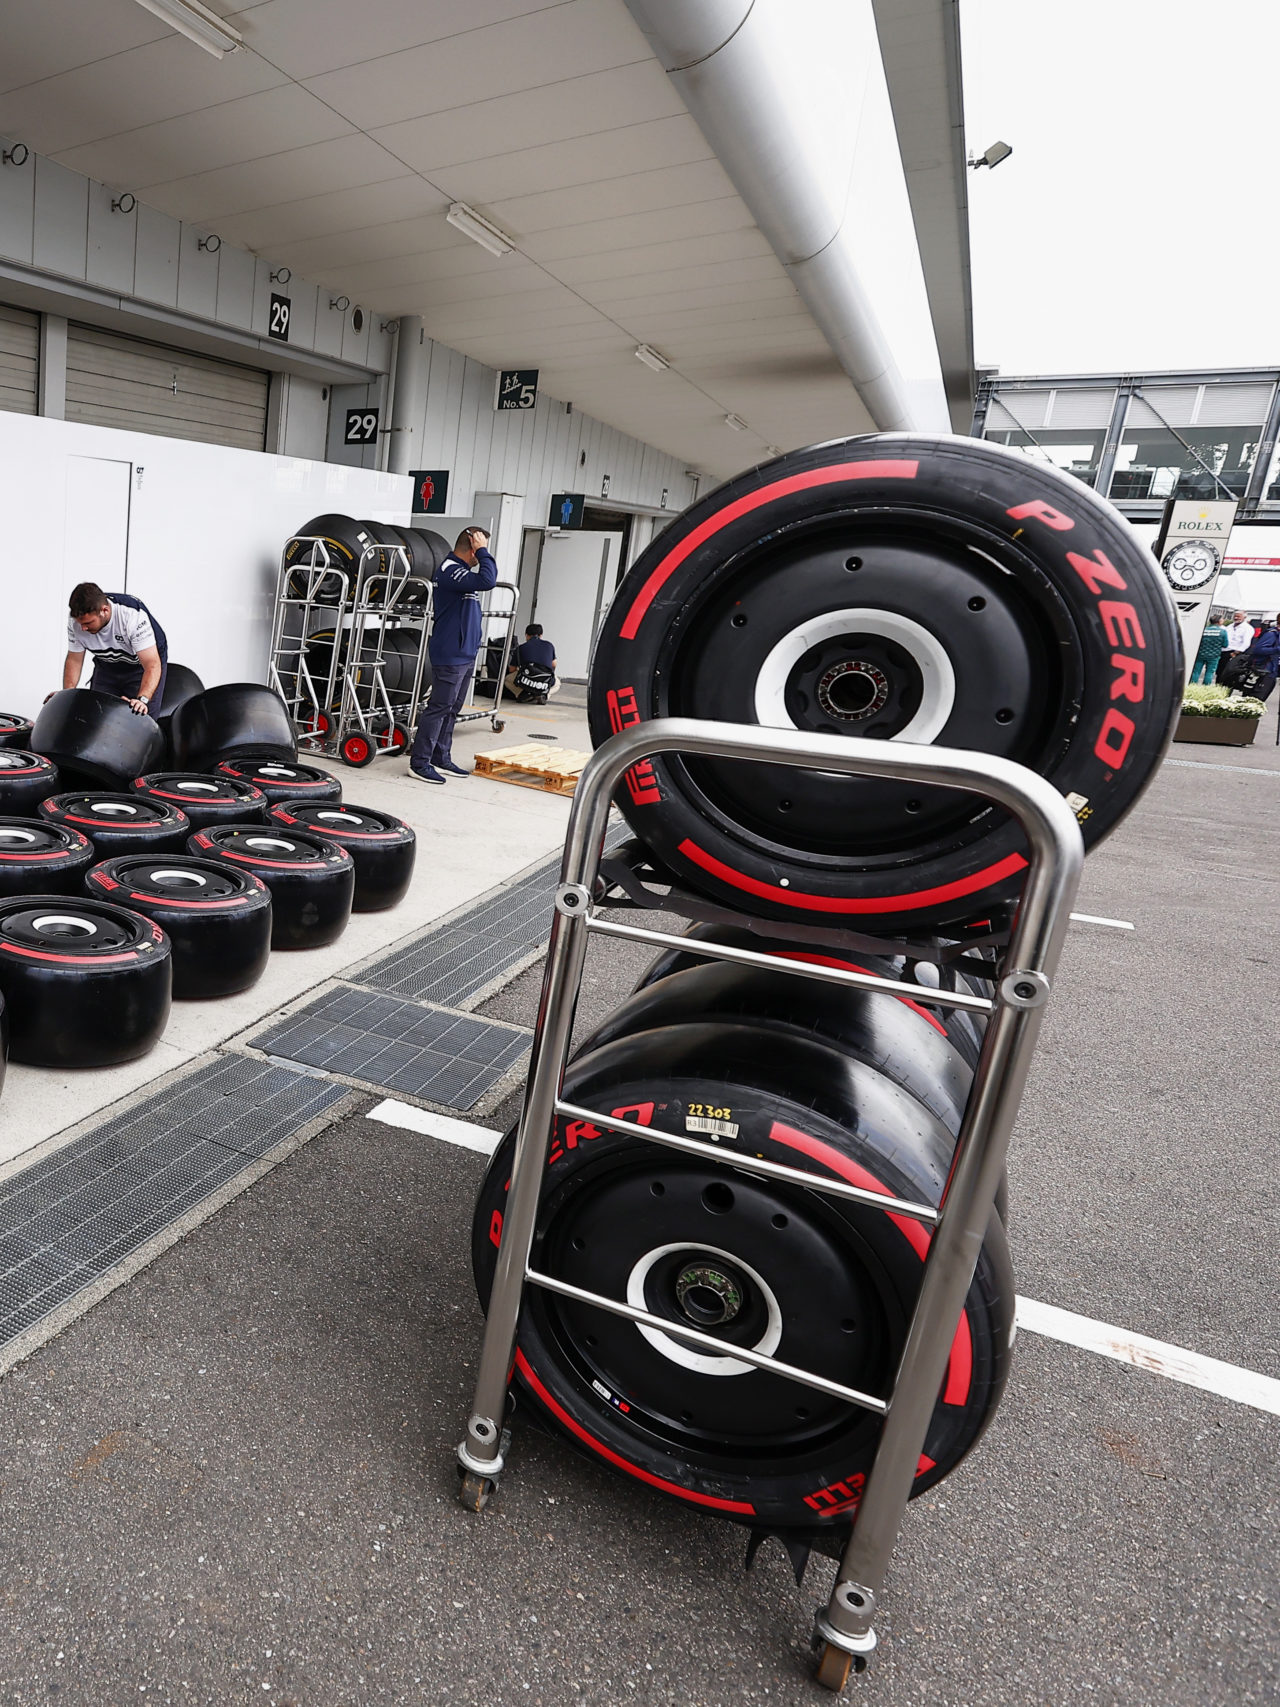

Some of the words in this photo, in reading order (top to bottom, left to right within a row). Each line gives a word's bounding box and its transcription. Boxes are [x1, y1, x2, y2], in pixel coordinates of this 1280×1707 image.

[271, 302, 289, 334] 29
[347, 414, 377, 439] 29
[1177, 521, 1224, 532] ROLEX
[1006, 499, 1075, 531] P
[1066, 549, 1146, 770] ZERO
[607, 686, 662, 805] PIRLLI
